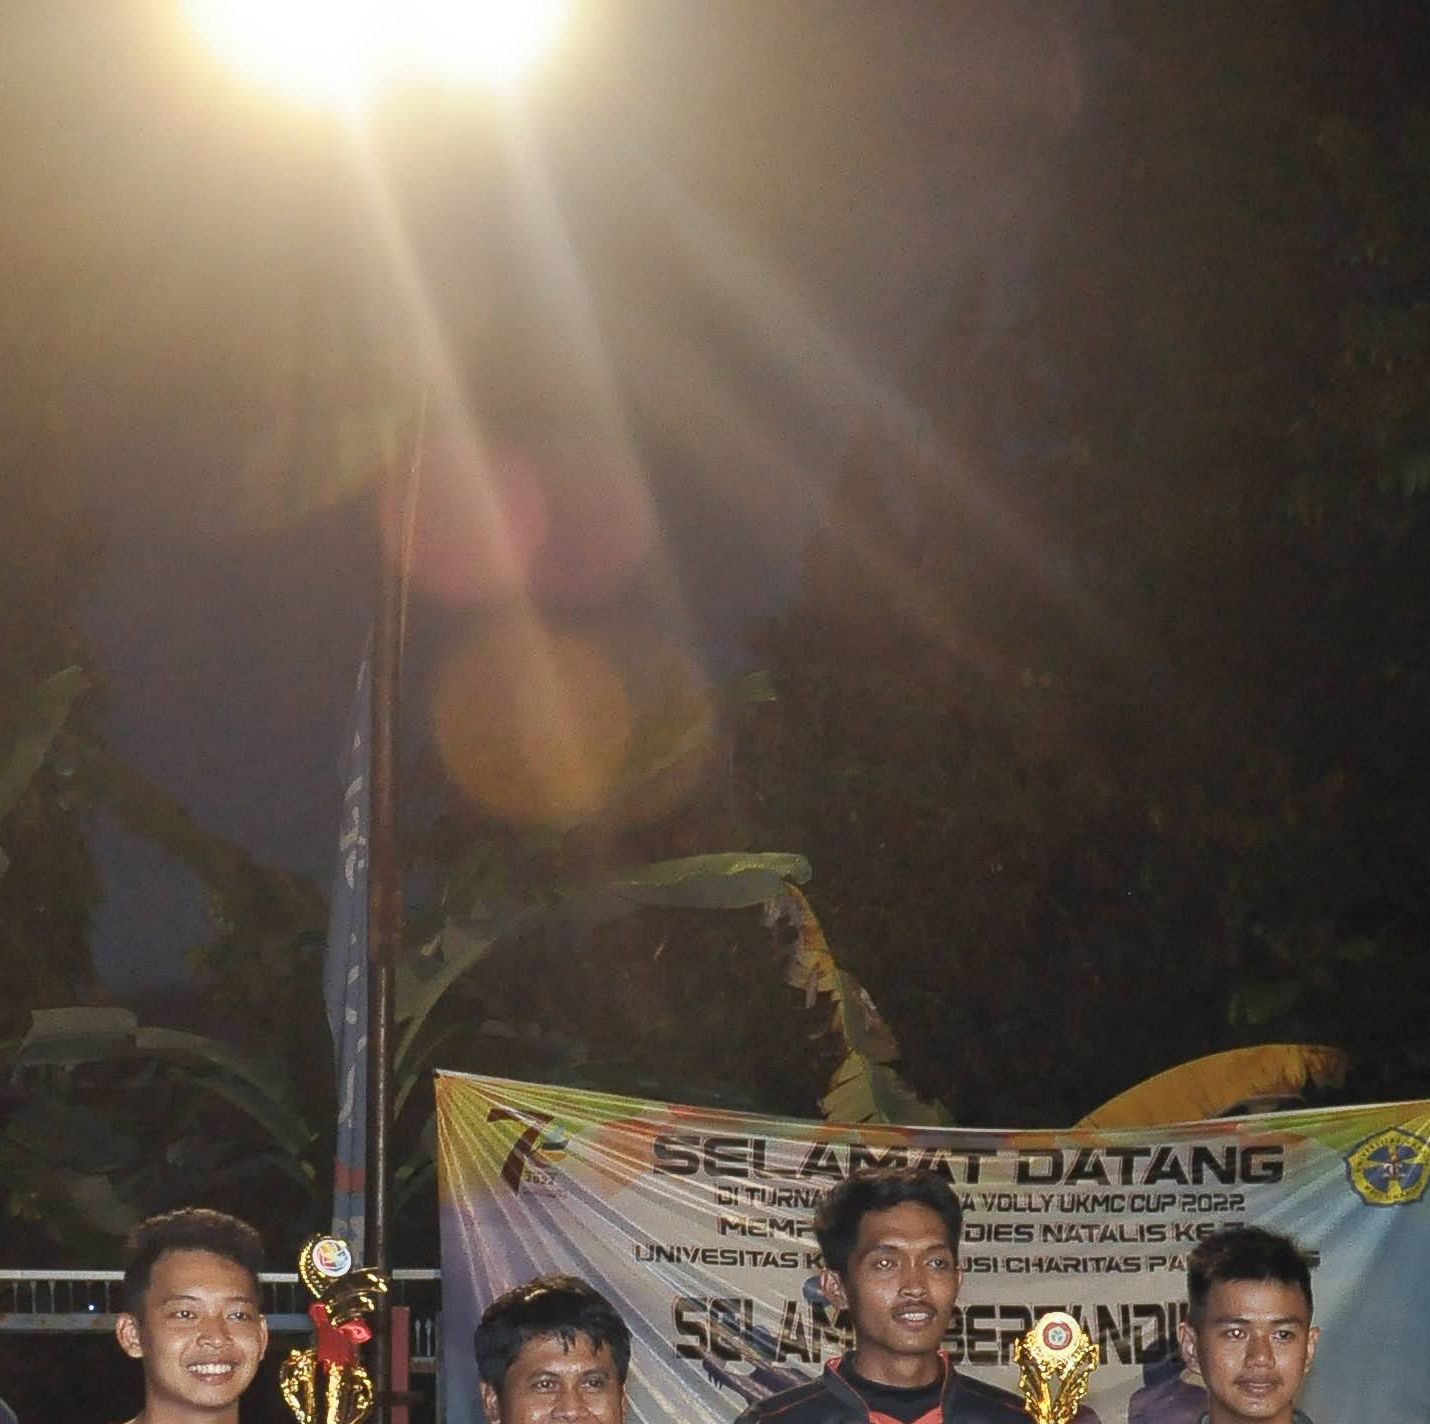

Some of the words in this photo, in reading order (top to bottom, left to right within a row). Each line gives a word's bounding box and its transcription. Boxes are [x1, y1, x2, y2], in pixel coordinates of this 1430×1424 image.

[652, 1134, 999, 1184] SELAMAT
[1017, 1145, 1285, 1185] DATANG
[715, 1184, 739, 1205] DI
[981, 1192, 1056, 1213] VOLLY
[1059, 1193, 1126, 1213] UKMC
[1129, 1193, 1177, 1213] CUP
[1181, 1193, 1246, 1212] 2022
[964, 1223, 1034, 1243] DIES
[1042, 1222, 1166, 1243] NATALIS
[634, 1245, 799, 1268] UNIVESITAS
[1005, 1255, 1141, 1274] CHARITAS
[674, 1296, 857, 1364] SELAM
